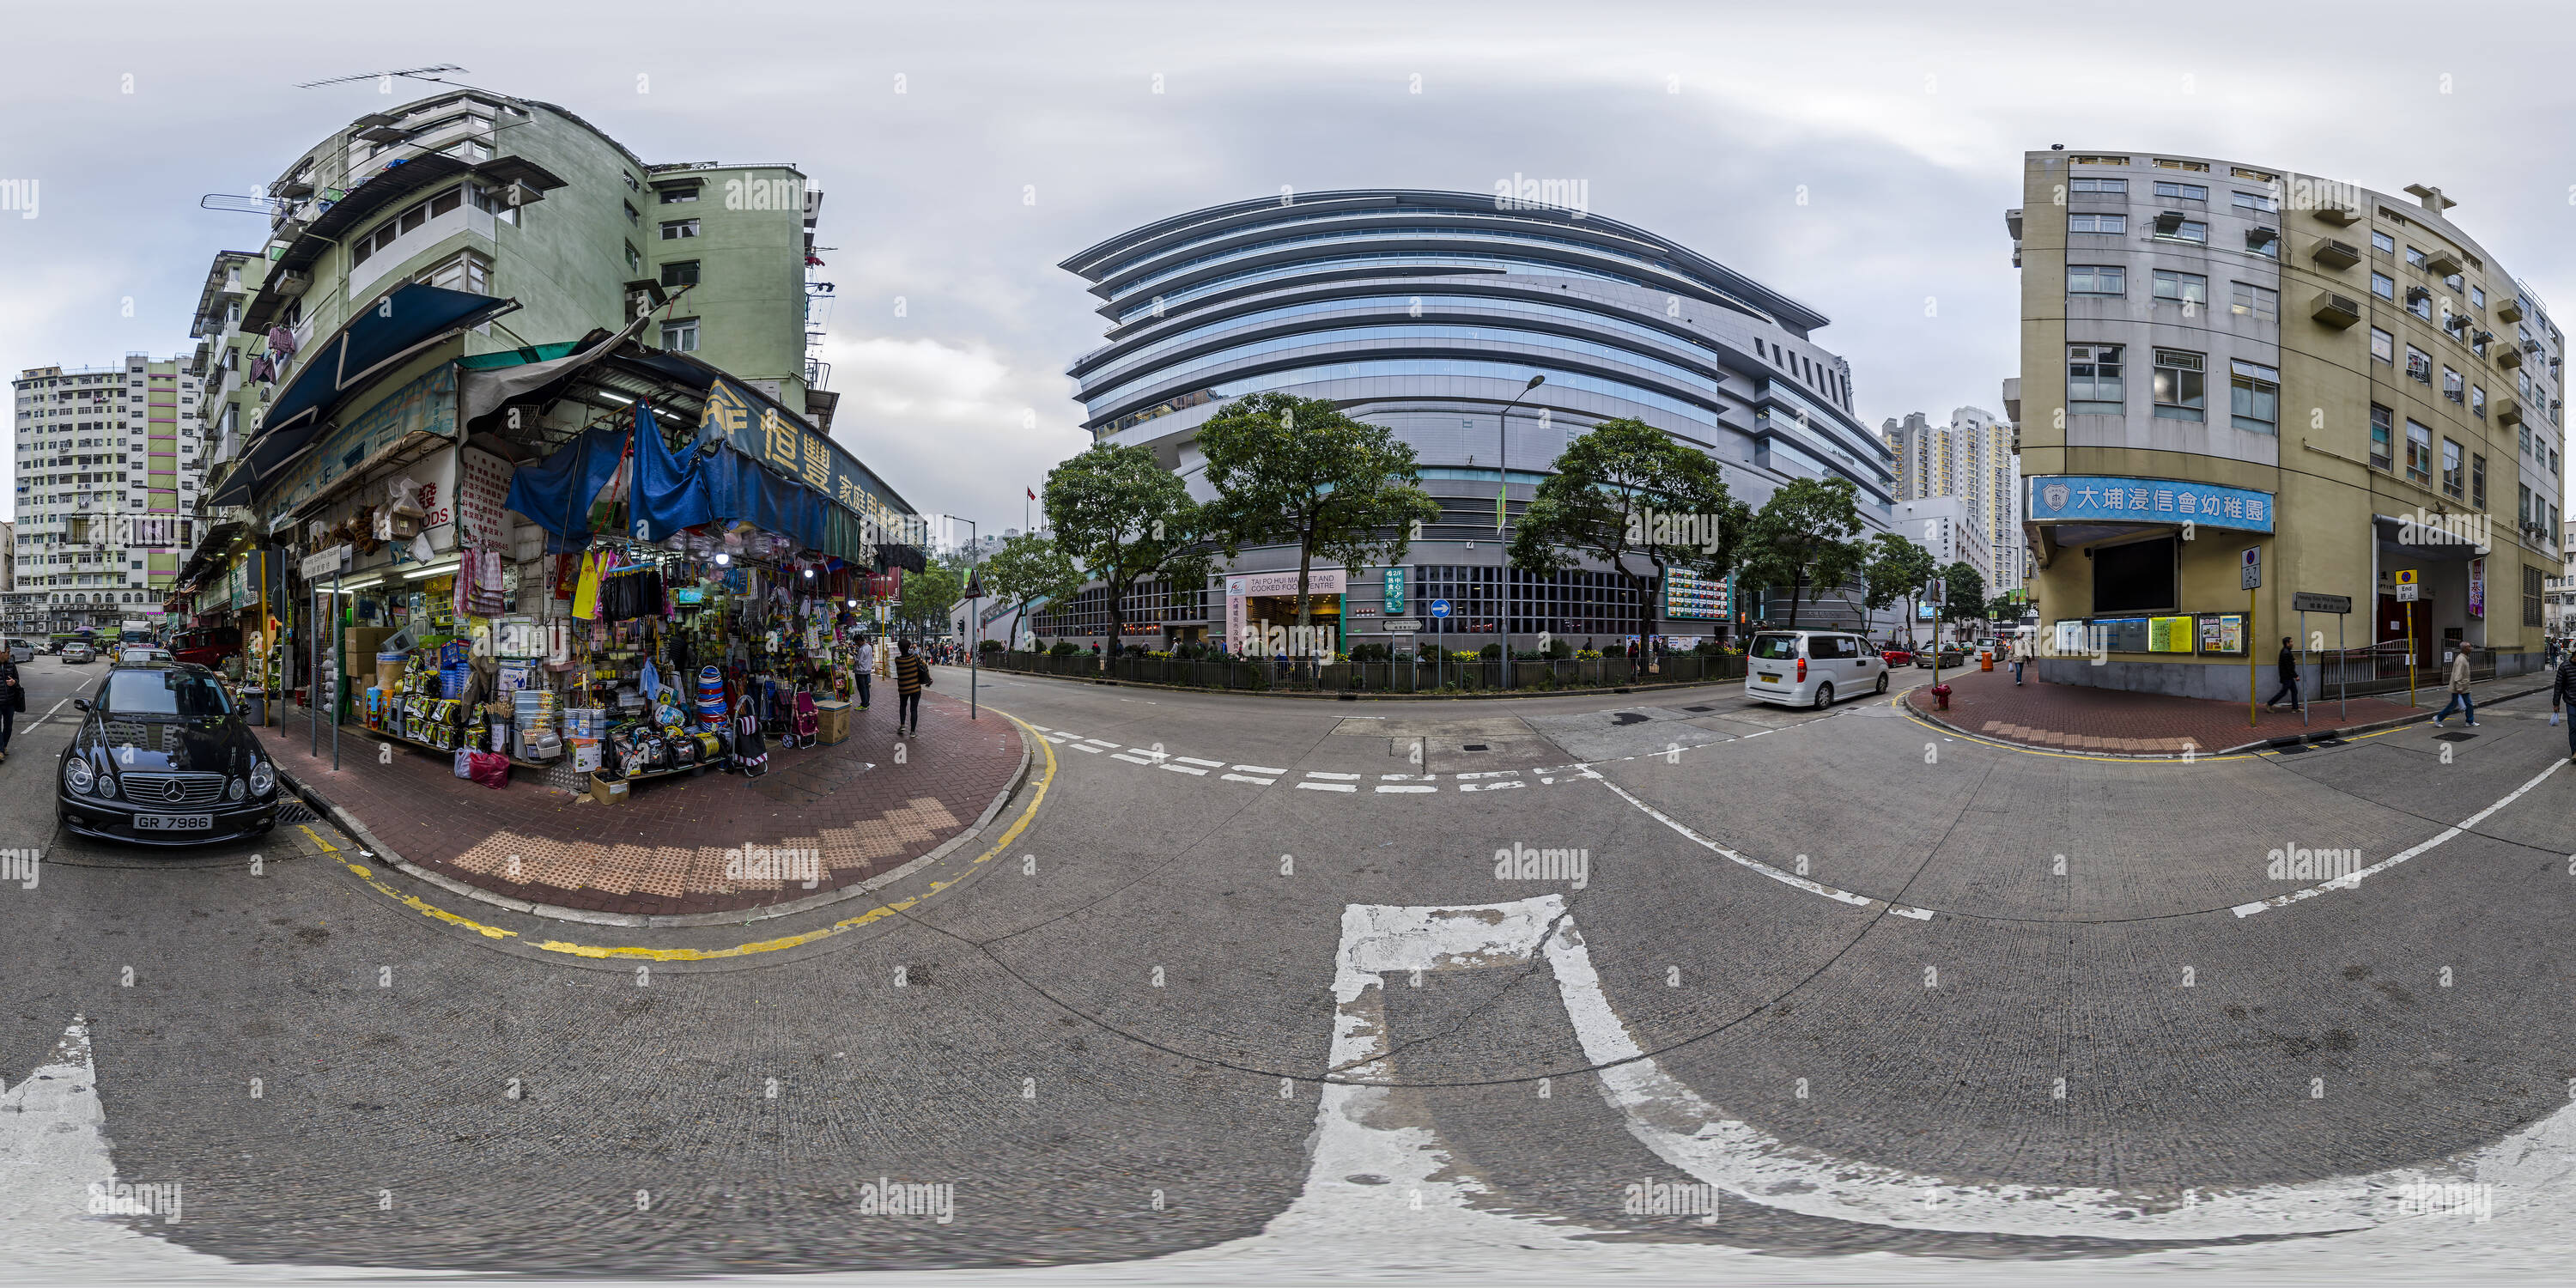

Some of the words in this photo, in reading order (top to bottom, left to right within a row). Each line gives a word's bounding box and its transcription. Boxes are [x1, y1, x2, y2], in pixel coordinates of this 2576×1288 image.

[760, 410, 830, 494] 恒豐
[2076, 485, 2264, 522] 大埔浸信會幼稚園
[139, 817, 160, 828] GR
[167, 817, 208, 828] 7986
